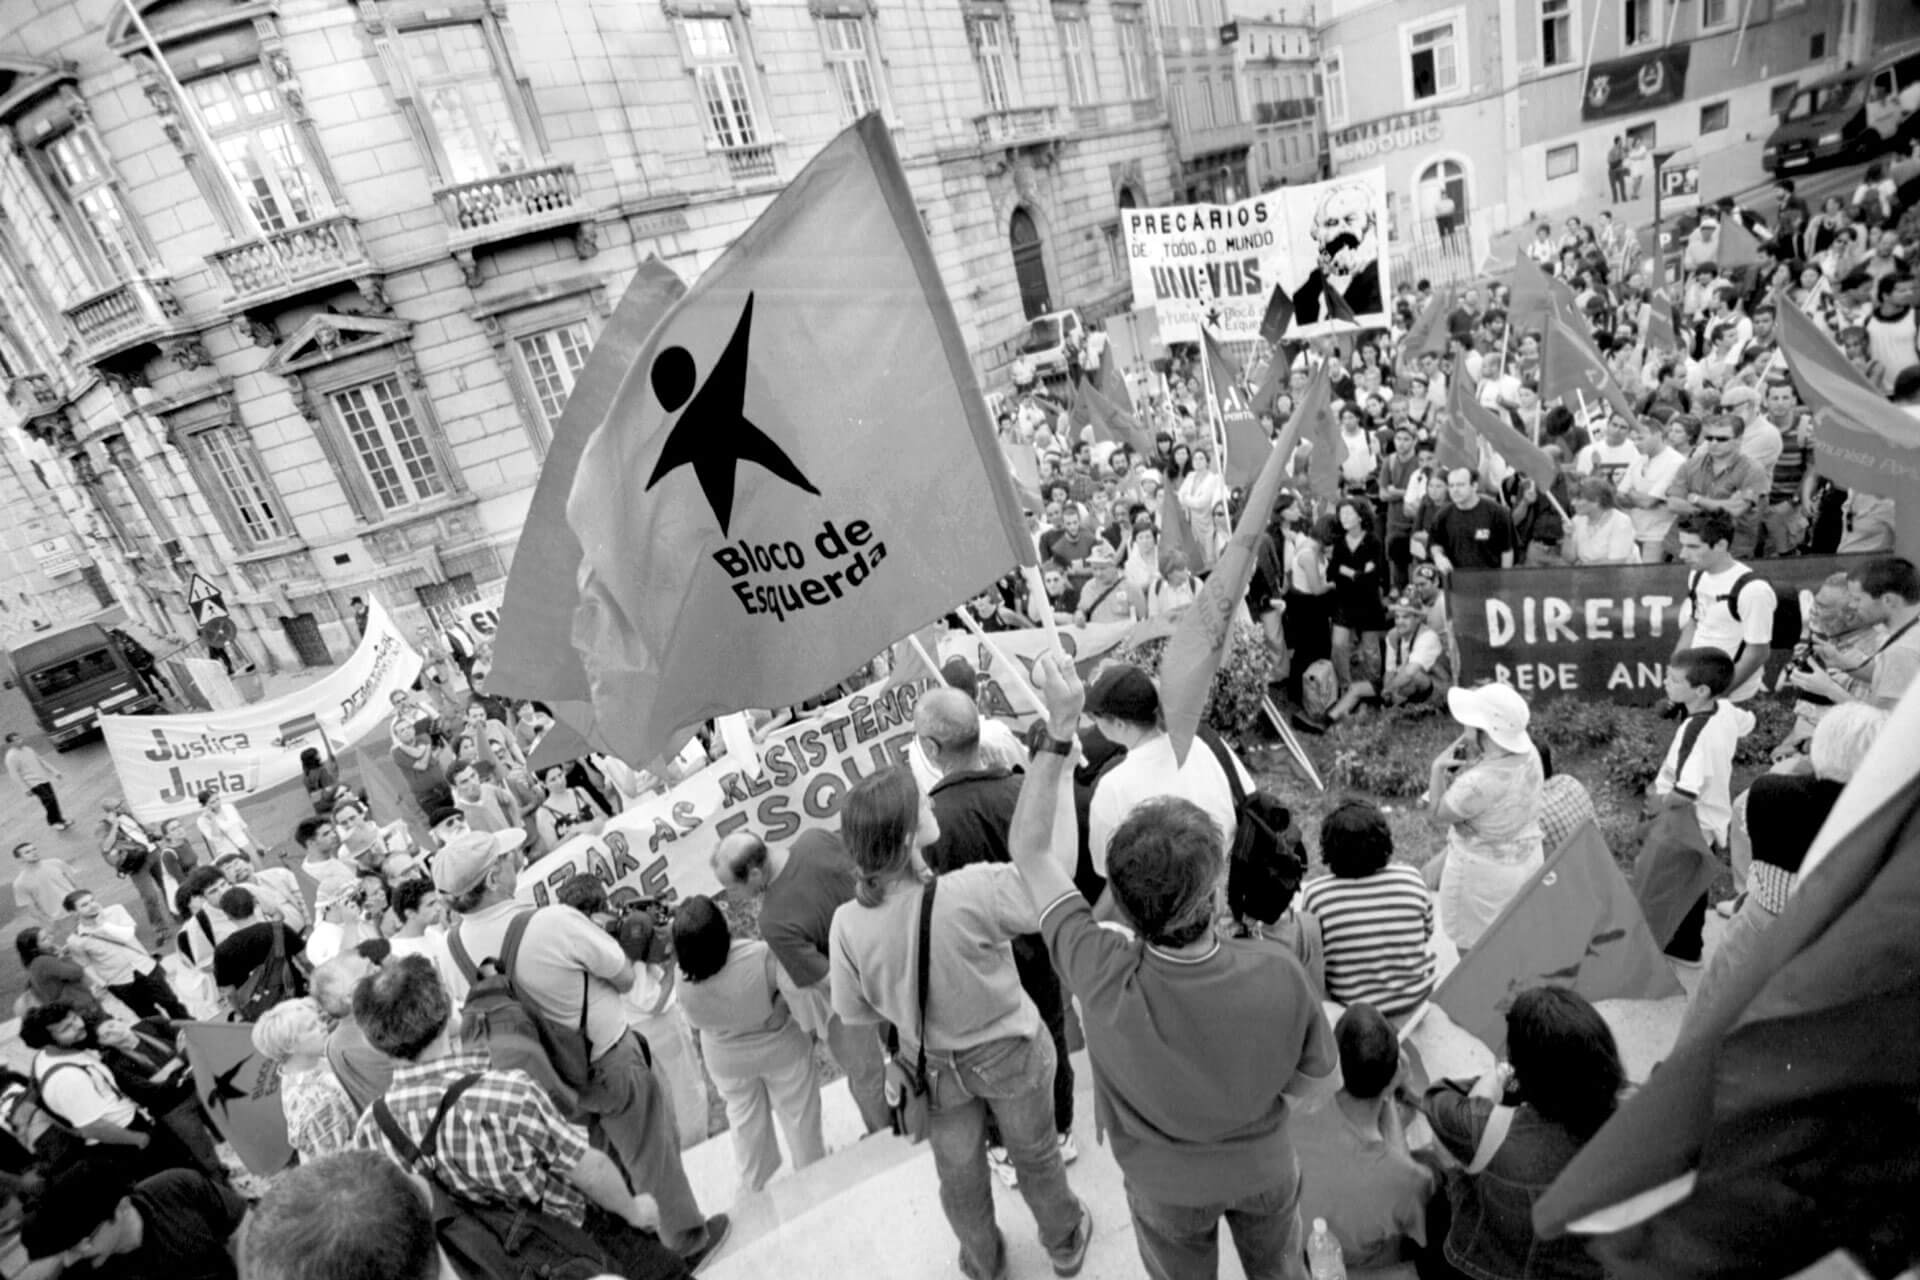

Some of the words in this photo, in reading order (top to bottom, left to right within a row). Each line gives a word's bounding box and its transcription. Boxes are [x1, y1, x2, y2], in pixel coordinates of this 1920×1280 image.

[1226, 230, 1274, 252] MUNDO
[712, 539, 805, 579] Bloco
[814, 519, 873, 560] de
[731, 541, 888, 623] Esquerda
[145, 727, 251, 763] Justiça
[648, 799, 704, 854] AS
